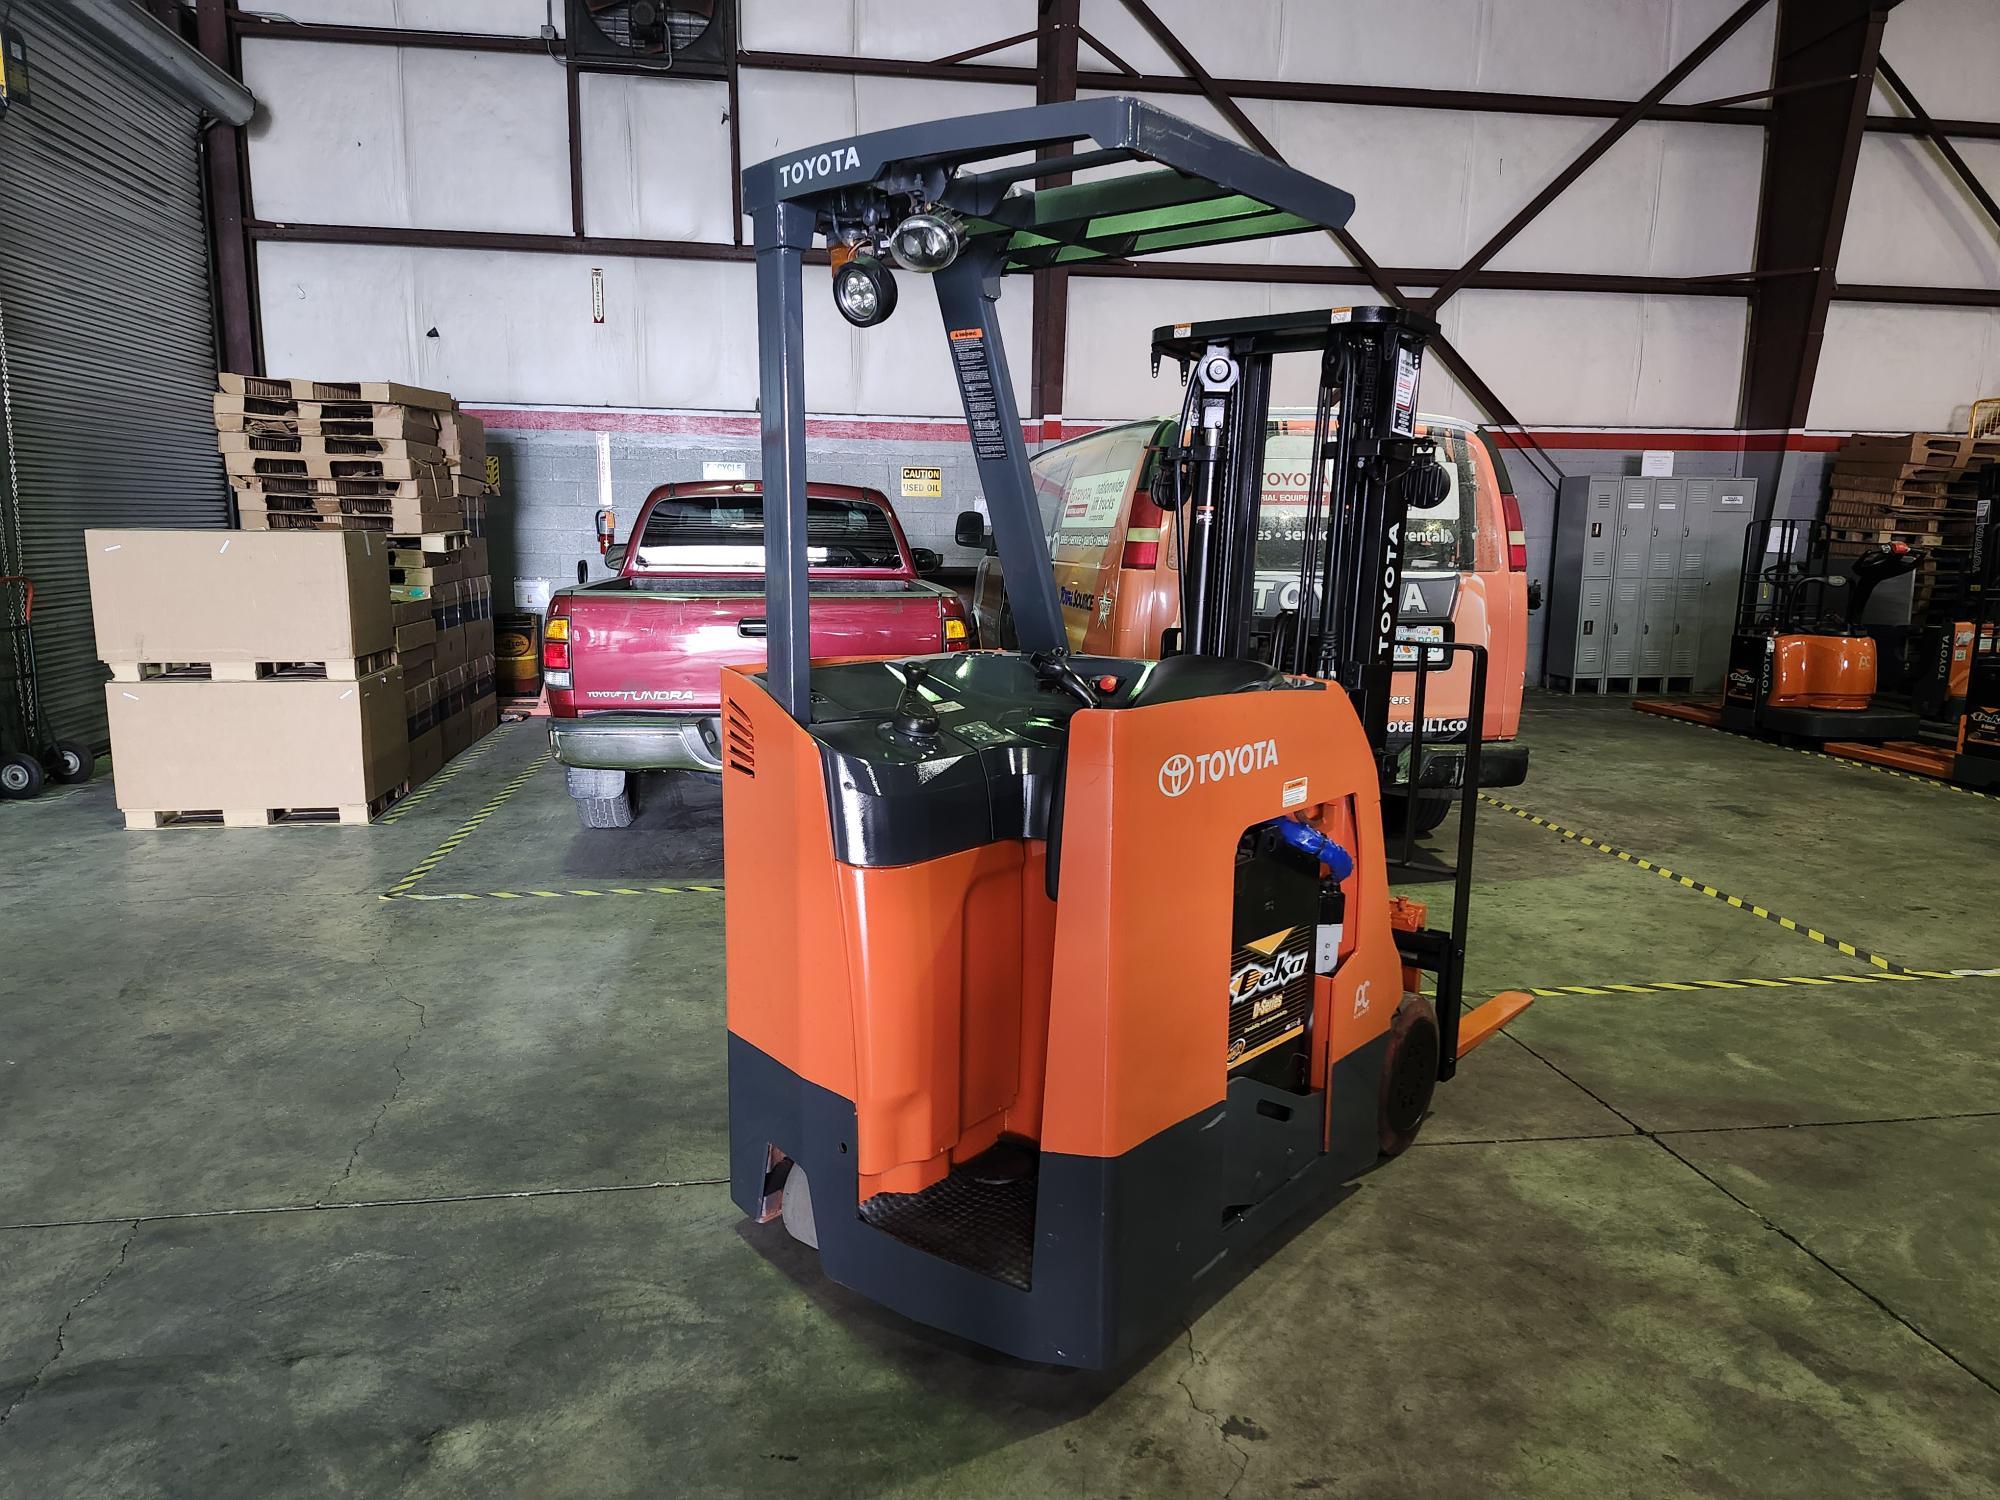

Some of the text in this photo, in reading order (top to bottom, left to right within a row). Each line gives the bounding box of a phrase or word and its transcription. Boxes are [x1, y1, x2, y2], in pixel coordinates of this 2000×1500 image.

[780, 146, 861, 188] TOYOTA
[903, 469, 940, 479] CAUTION
[1263, 472, 1330, 486] OYOA
[904, 483, 940, 492] USED OIL
[1280, 494, 1327, 502] EQUIPT
[1254, 580, 1428, 614] TOA
[1378, 522, 1400, 655] TOYOTA
[1938, 635, 1950, 680] TOYOTA
[620, 690, 694, 701] TUNDRA
[1390, 695, 1411, 705] ers
[1197, 739, 1278, 785] TOYOTA
[1231, 952, 1308, 1003] Deka
